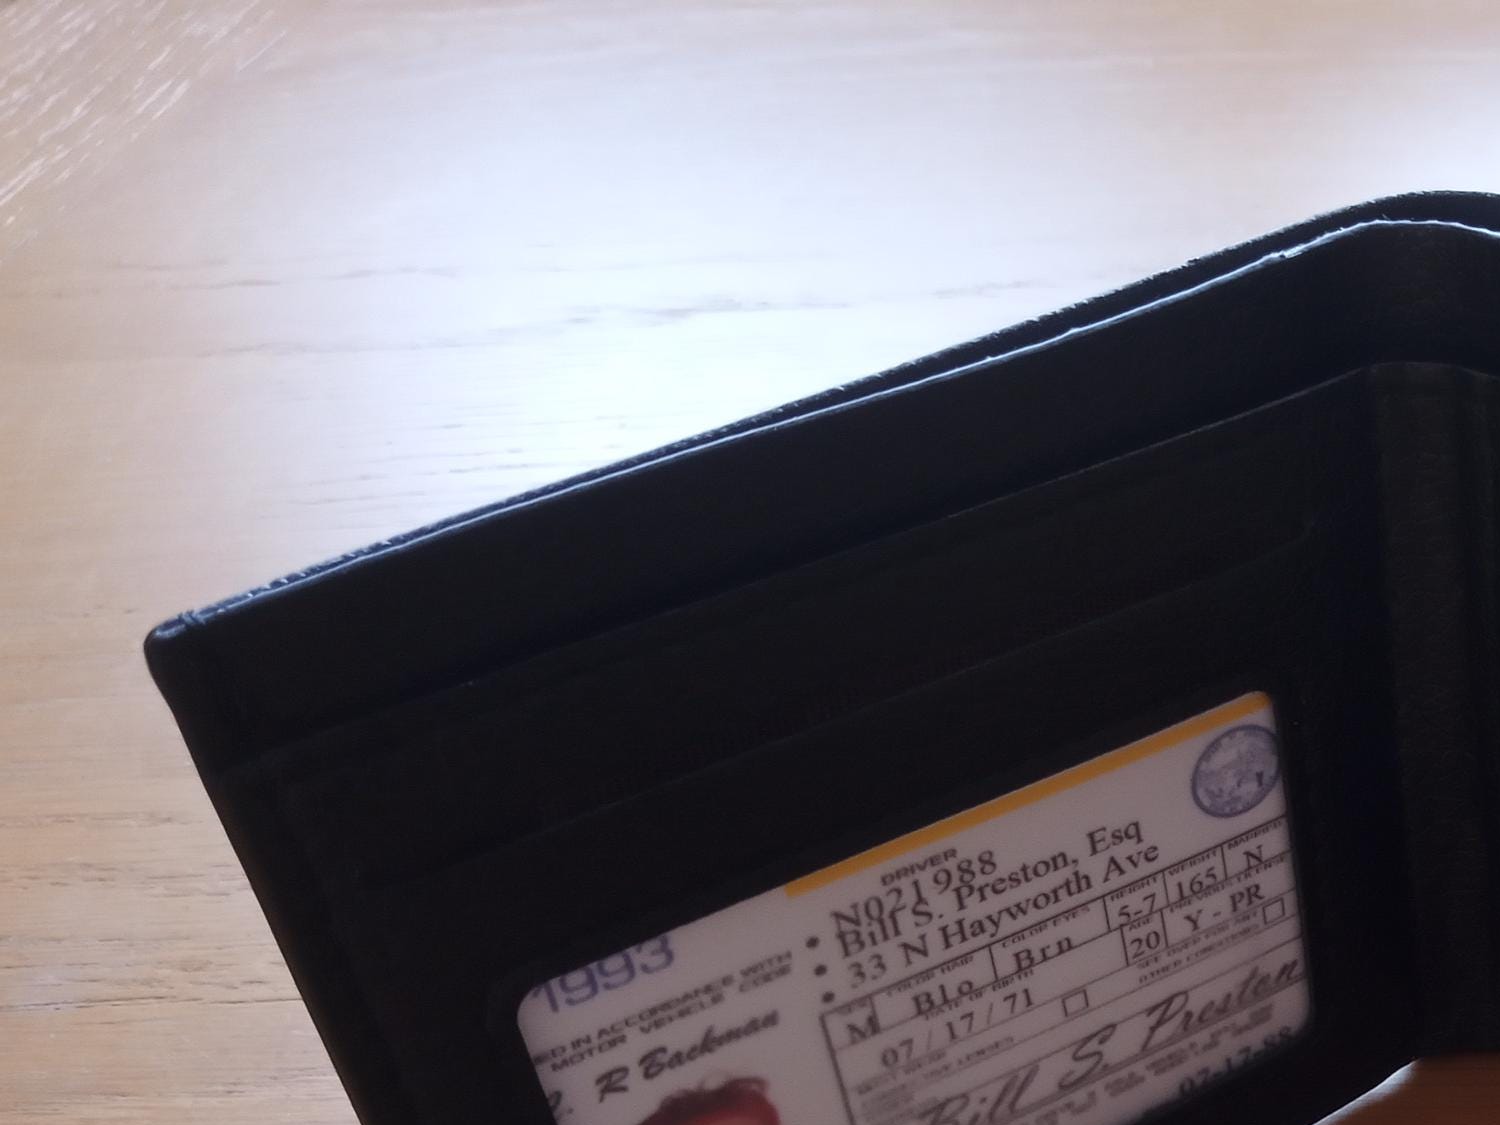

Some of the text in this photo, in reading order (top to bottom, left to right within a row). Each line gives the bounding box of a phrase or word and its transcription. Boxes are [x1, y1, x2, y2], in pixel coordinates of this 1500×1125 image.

[952, 850, 1079, 912] Preston,
[1086, 820, 1144, 857] Esq
[1176, 866, 1218, 902] 165
[847, 844, 1161, 990] 33 N Hayworth Ave
[1130, 930, 1161, 960] 20
